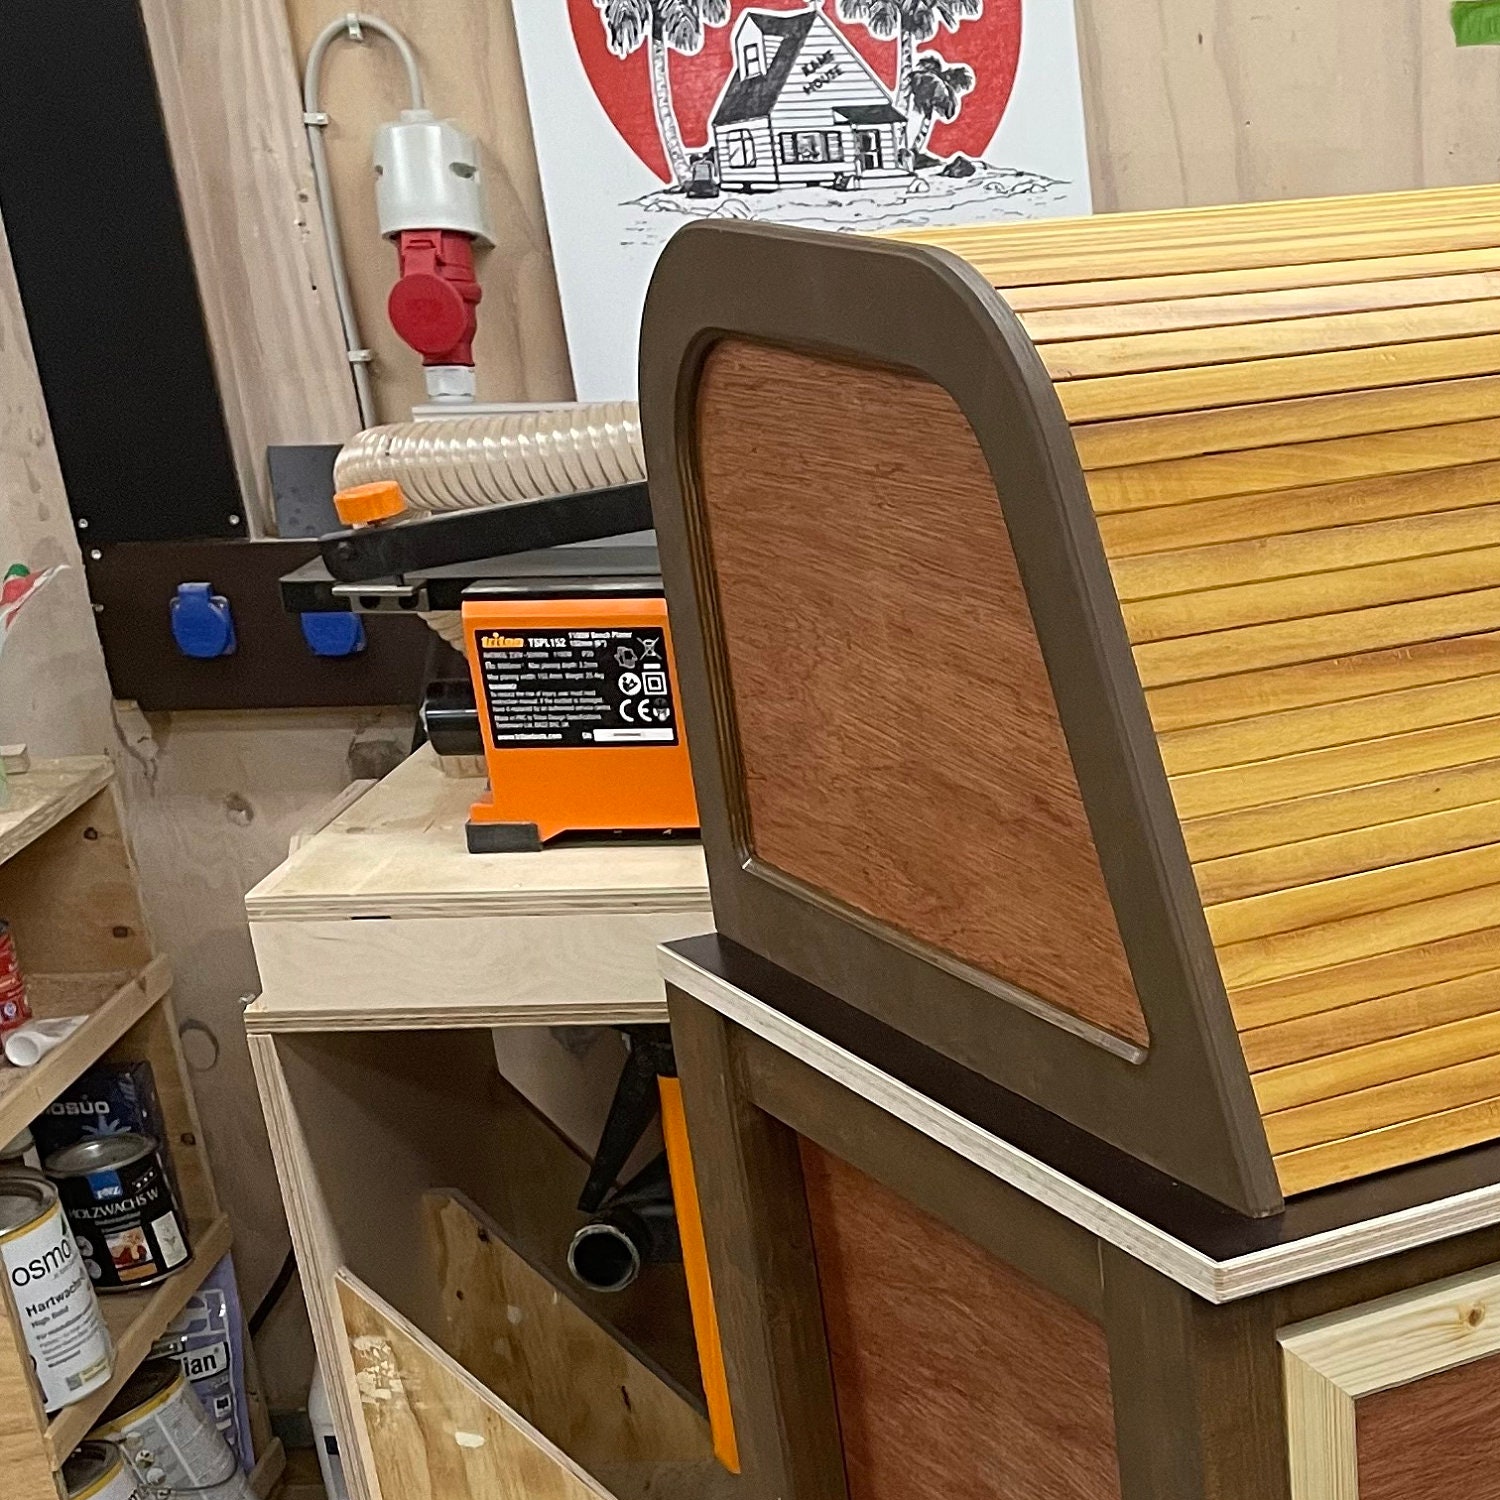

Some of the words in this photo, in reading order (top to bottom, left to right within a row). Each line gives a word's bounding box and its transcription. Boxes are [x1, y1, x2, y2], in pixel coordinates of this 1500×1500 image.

[801, 48, 835, 77] KAME
[802, 64, 843, 96] HOUSE
[12, 1239, 71, 1287] osmo
